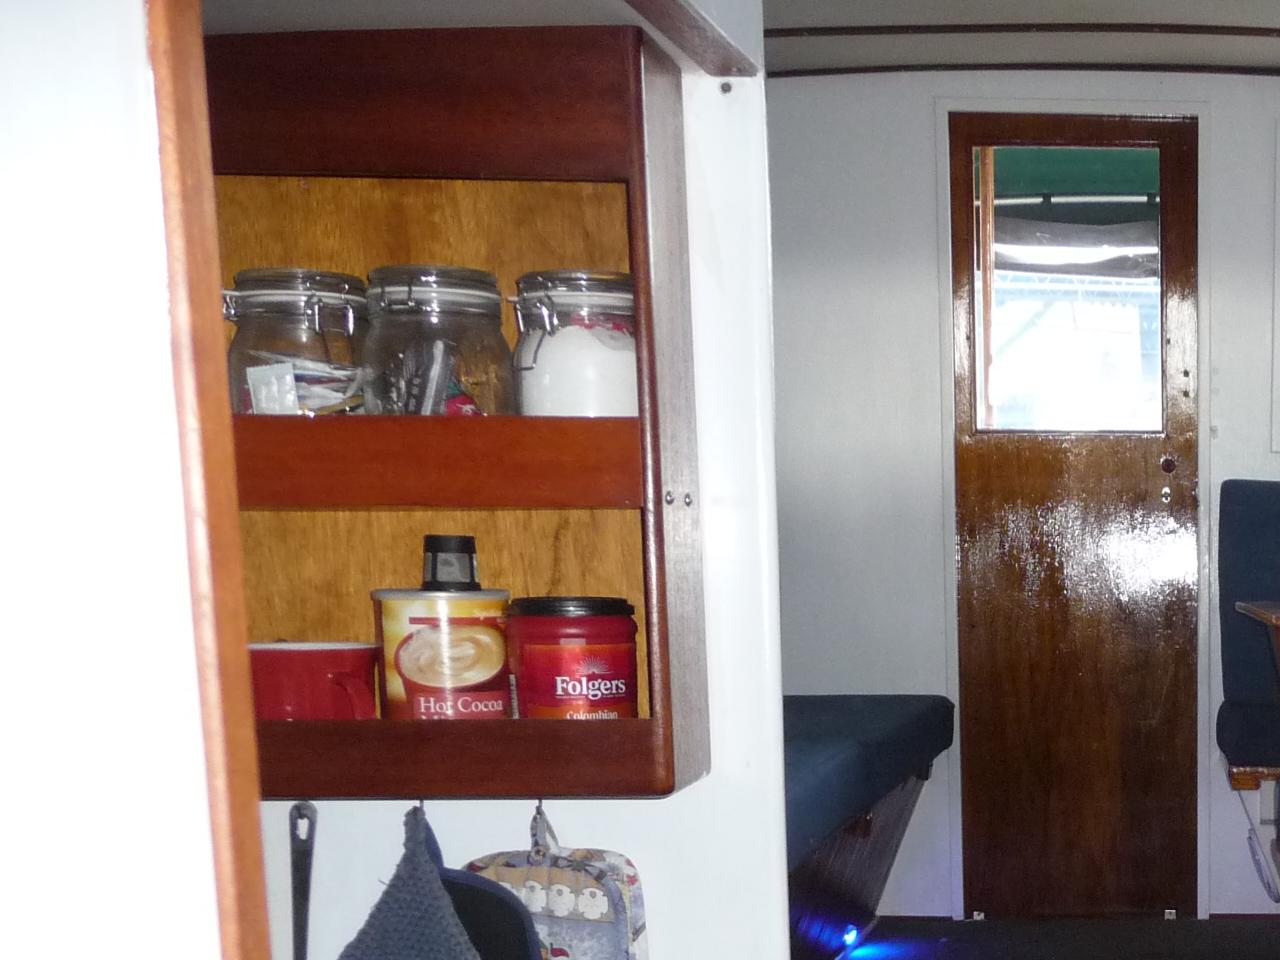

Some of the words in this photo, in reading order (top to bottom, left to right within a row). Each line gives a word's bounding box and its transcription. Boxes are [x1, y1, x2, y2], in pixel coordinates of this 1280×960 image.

[555, 676, 626, 700] Folgers
[419, 697, 453, 713] Hot
[457, 697, 503, 712] Cocoa
